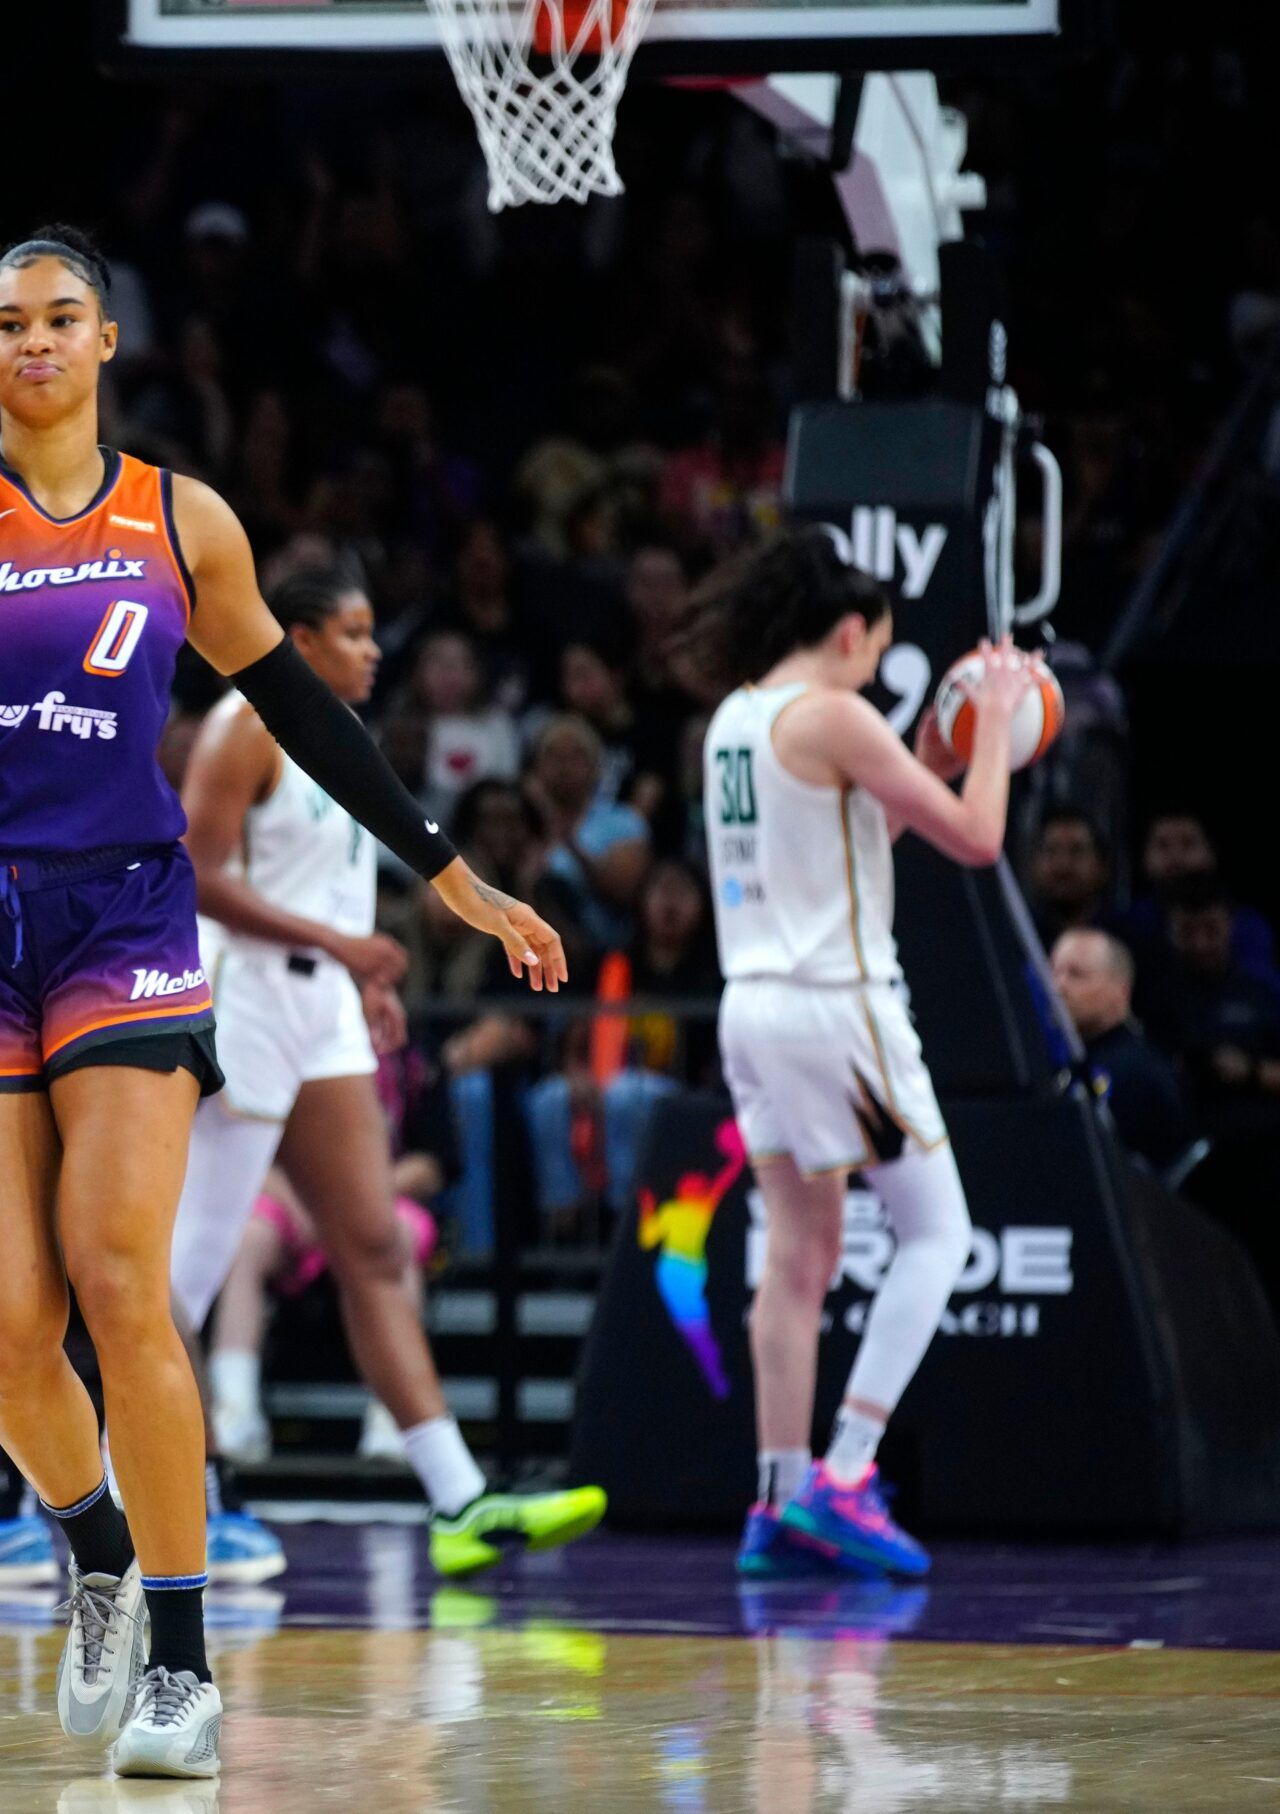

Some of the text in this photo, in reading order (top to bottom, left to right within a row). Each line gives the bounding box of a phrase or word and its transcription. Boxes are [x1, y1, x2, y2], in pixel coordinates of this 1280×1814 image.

[83, 600, 148, 677] 0
[31, 690, 118, 740] fry's
[717, 748, 758, 826] 30
